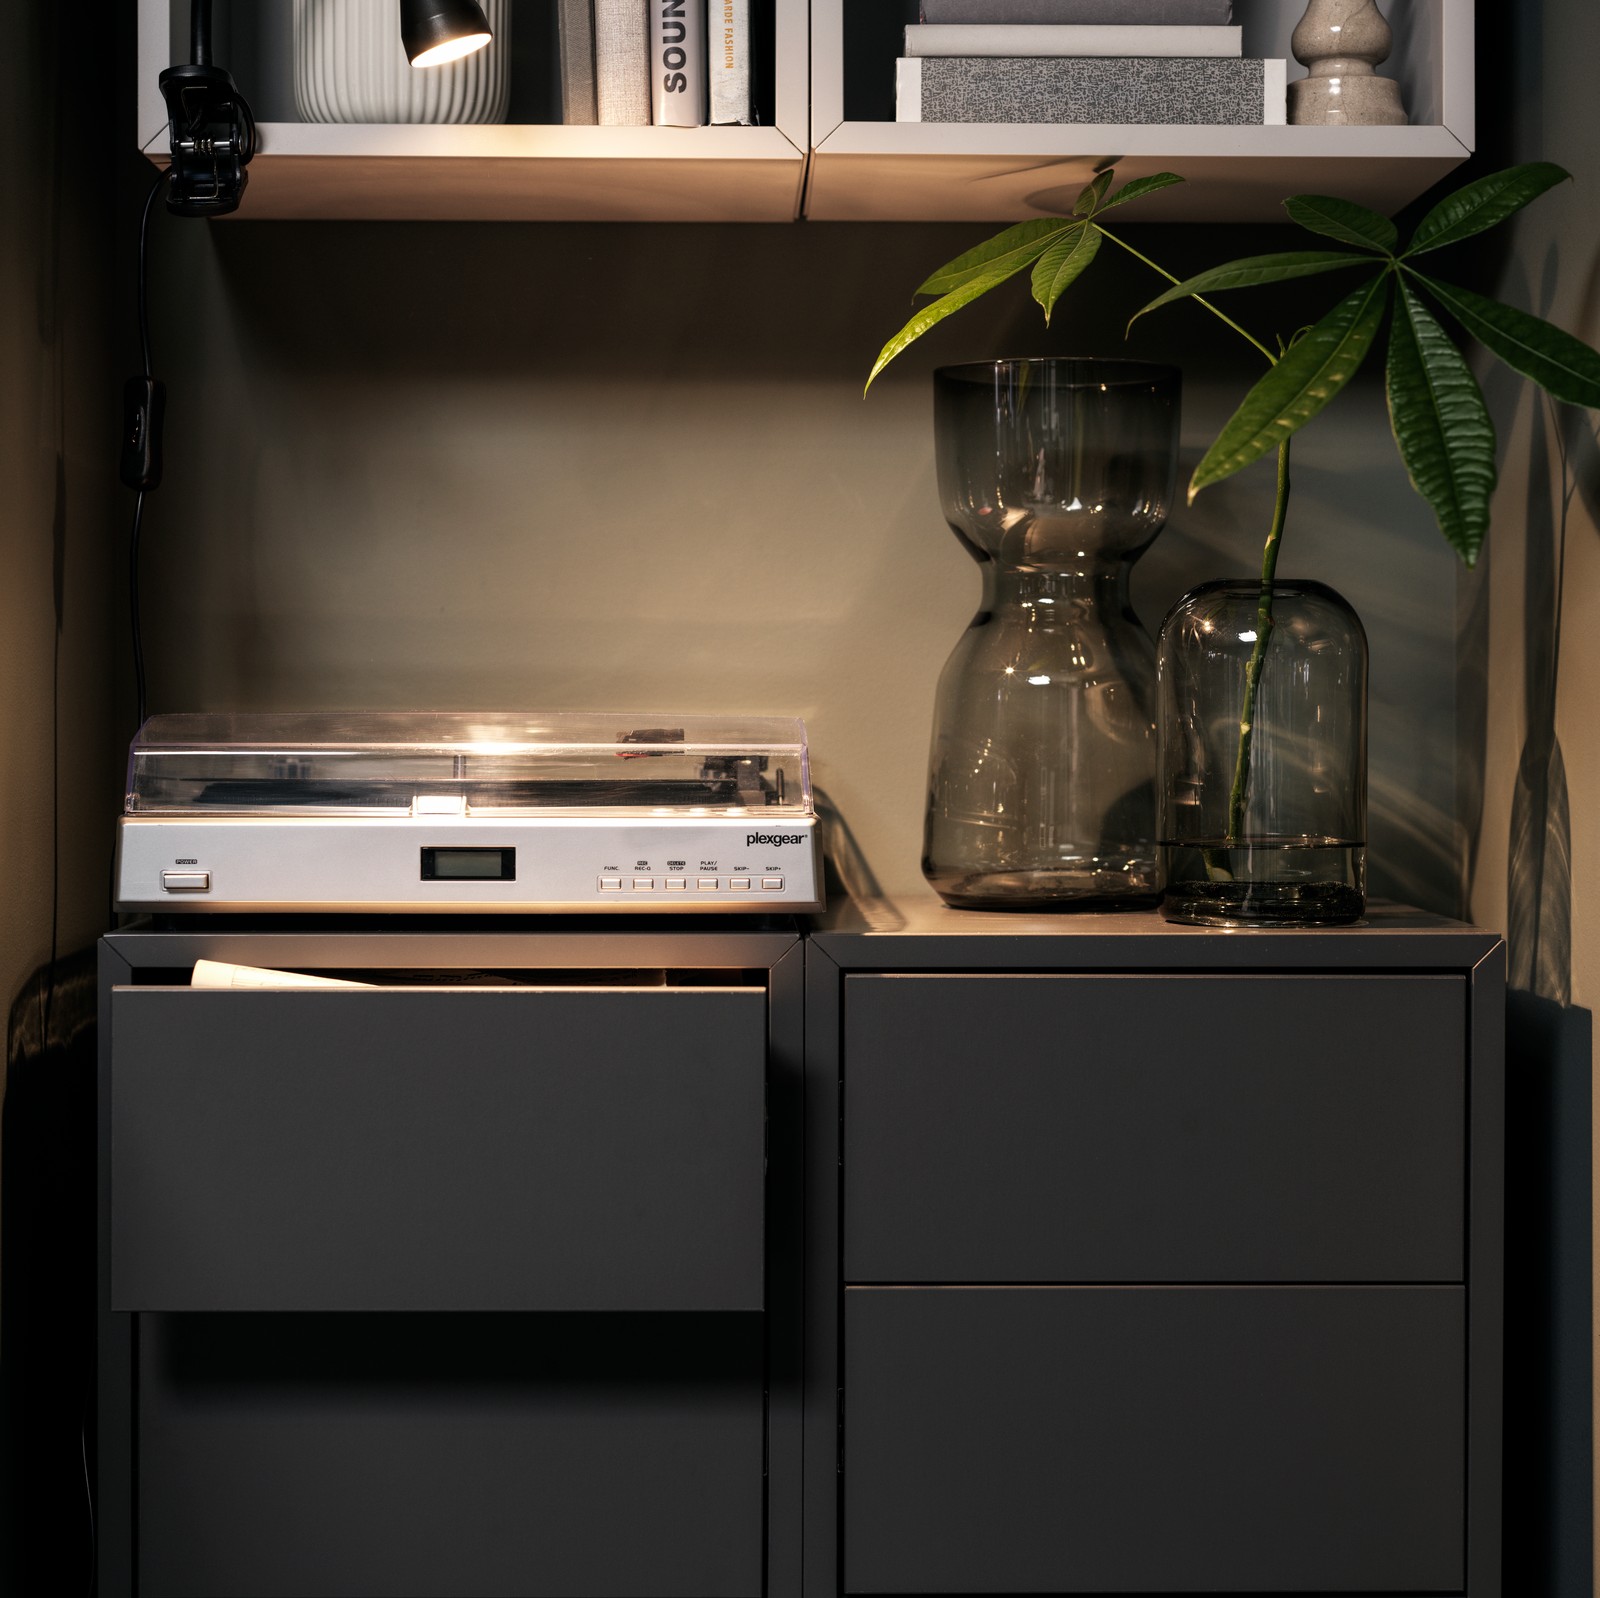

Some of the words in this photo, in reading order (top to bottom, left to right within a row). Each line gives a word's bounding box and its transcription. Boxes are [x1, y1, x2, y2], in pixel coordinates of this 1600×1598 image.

[724, 0, 733, 24] ARDE
[662, 0, 687, 93] SOUN
[724, 28, 734, 69] FASHION
